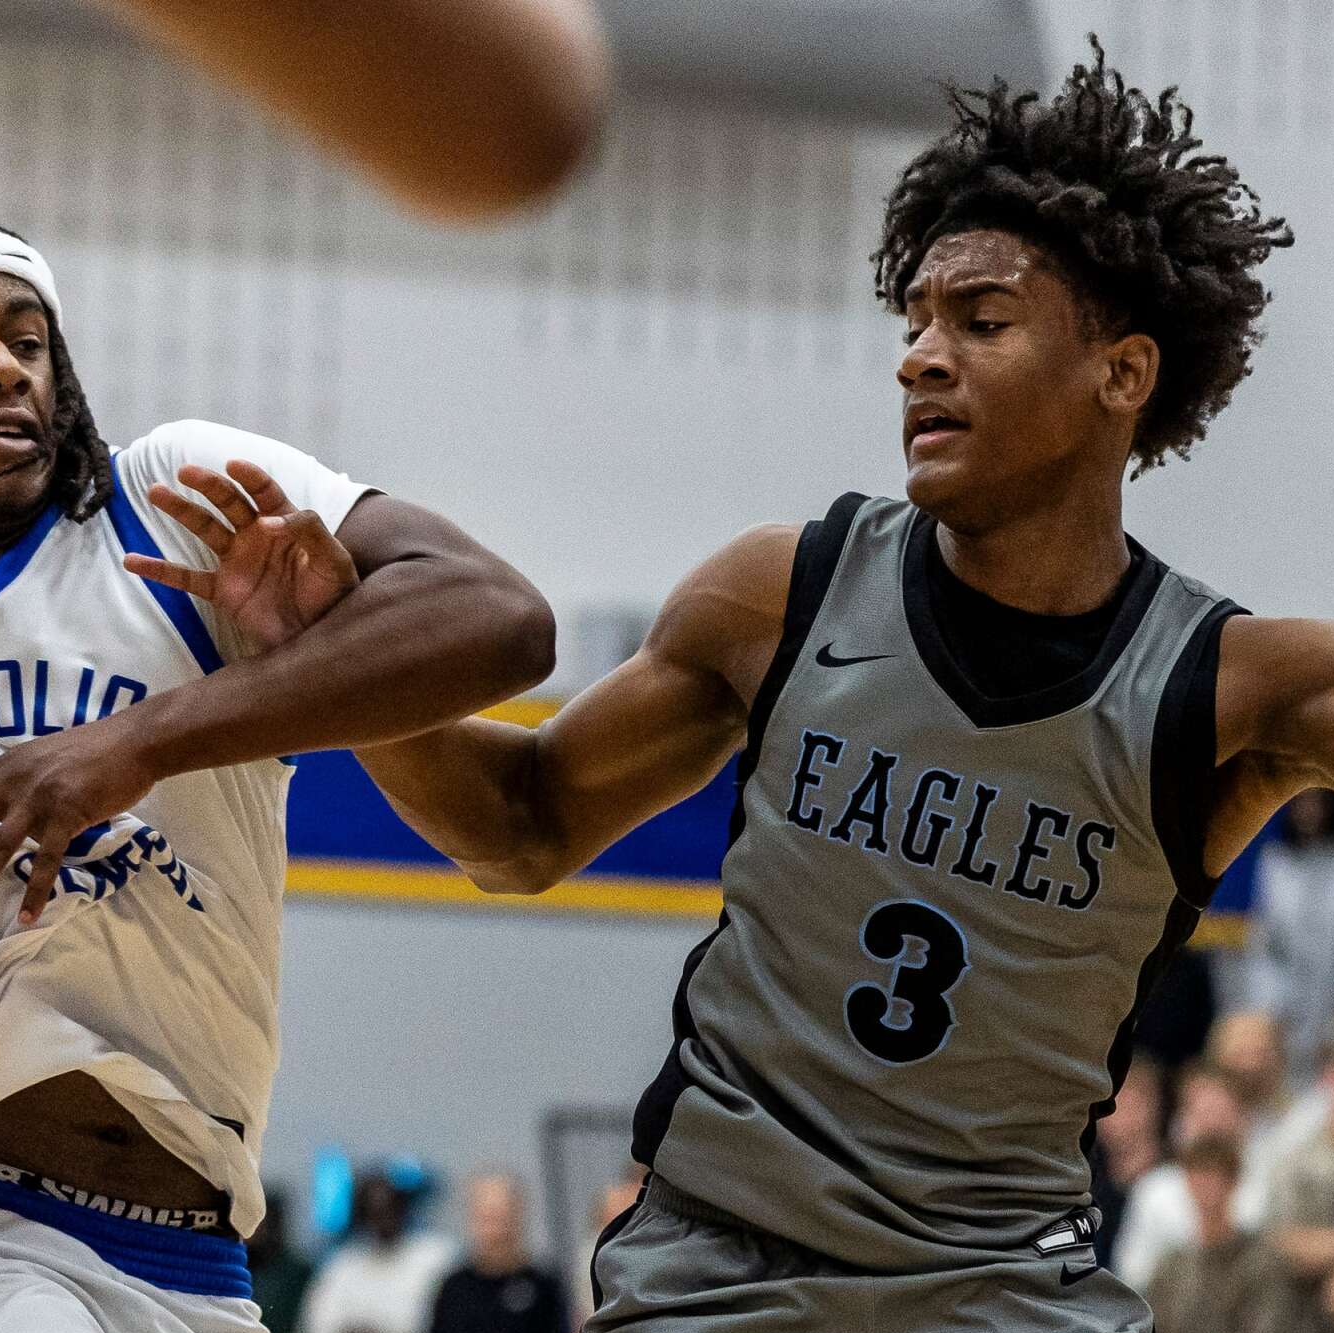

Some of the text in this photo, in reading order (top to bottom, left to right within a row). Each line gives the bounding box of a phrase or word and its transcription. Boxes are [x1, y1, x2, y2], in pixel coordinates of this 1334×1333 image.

[785, 728, 1118, 913] EAGLES
[844, 898, 972, 1067] 3
[1075, 1217, 1091, 1235] M
